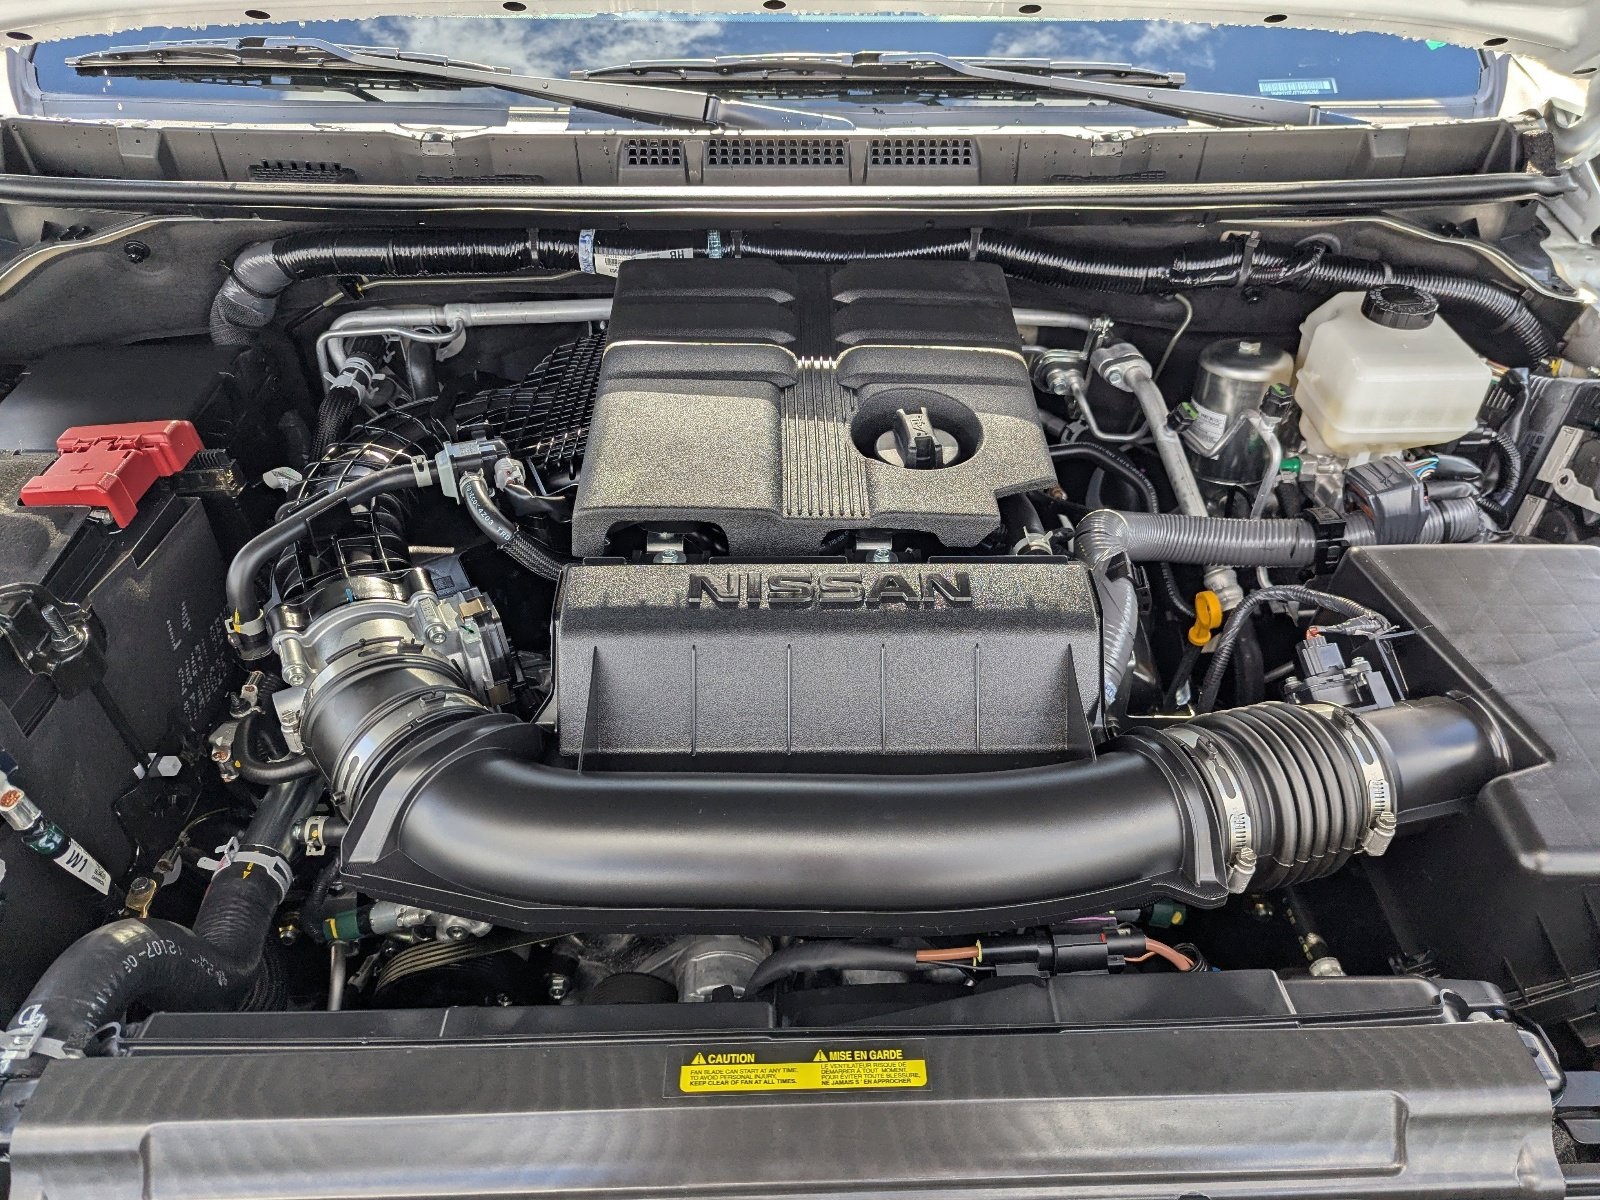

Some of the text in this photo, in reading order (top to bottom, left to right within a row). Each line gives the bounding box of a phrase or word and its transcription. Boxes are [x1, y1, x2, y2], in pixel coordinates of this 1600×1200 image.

[689, 572, 972, 606] NISSAN
[66, 849, 88, 873] W1
[708, 1054, 755, 1064] CAUTION
[829, 1050, 903, 1060] MISE EN GARDE
